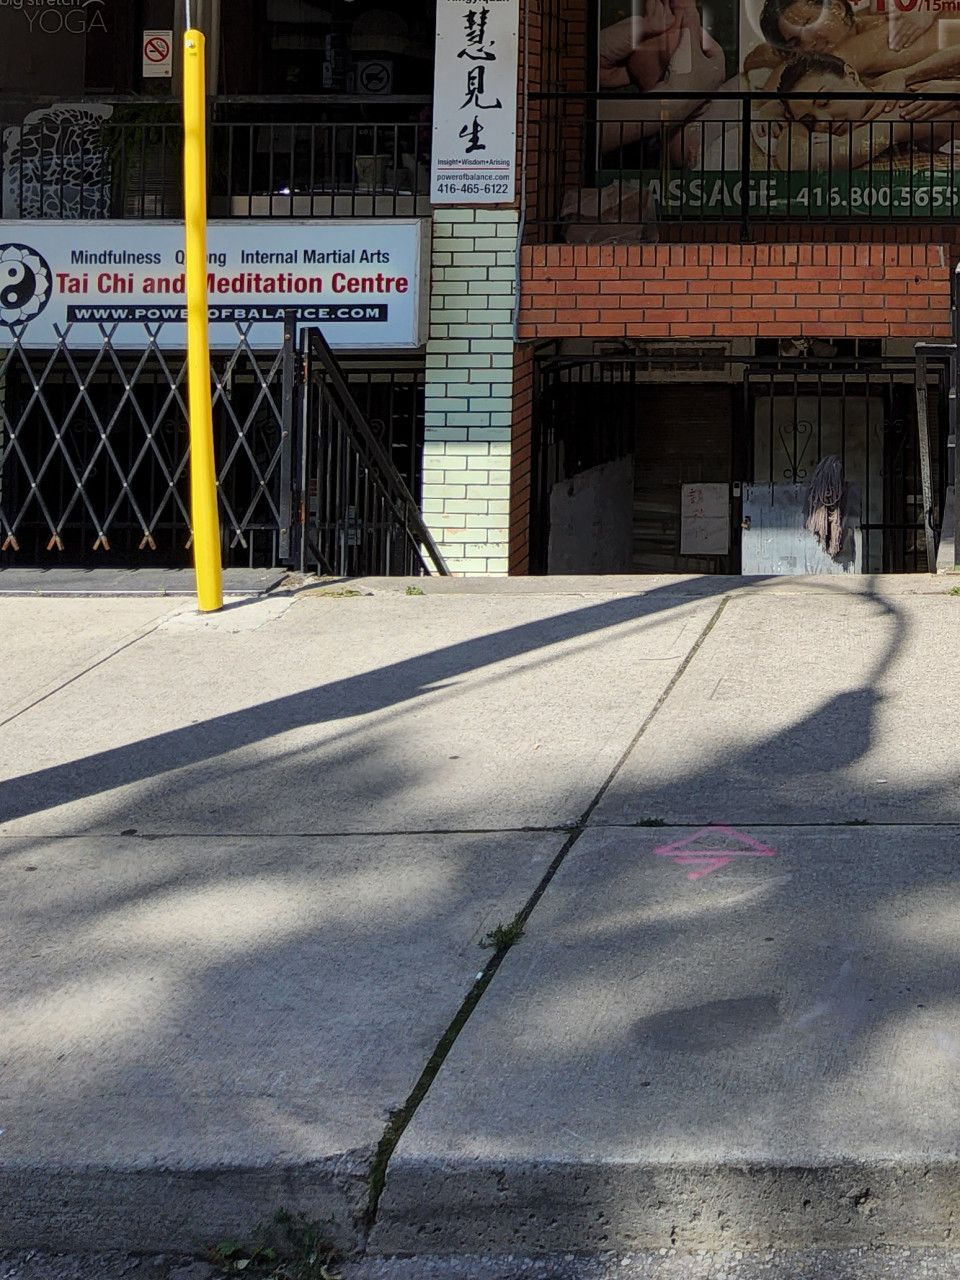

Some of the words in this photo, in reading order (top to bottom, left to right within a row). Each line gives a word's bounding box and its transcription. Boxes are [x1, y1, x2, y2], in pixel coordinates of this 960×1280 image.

[23, 8, 107, 34] YOGA
[436, 173, 510, 182] powerofbalance.com
[437, 183, 508, 194] 416-465-6122
[796, 186, 959, 207] 416.800.5655
[70, 250, 161, 265] Mindfulness
[241, 249, 298, 264] Internal
[303, 249, 356, 264] Martial
[359, 250, 390, 264] Arts
[56, 272, 89, 294] Tai
[97, 272, 134, 294] Chi
[142, 272, 186, 294] and
[331, 272, 409, 293] Centre
